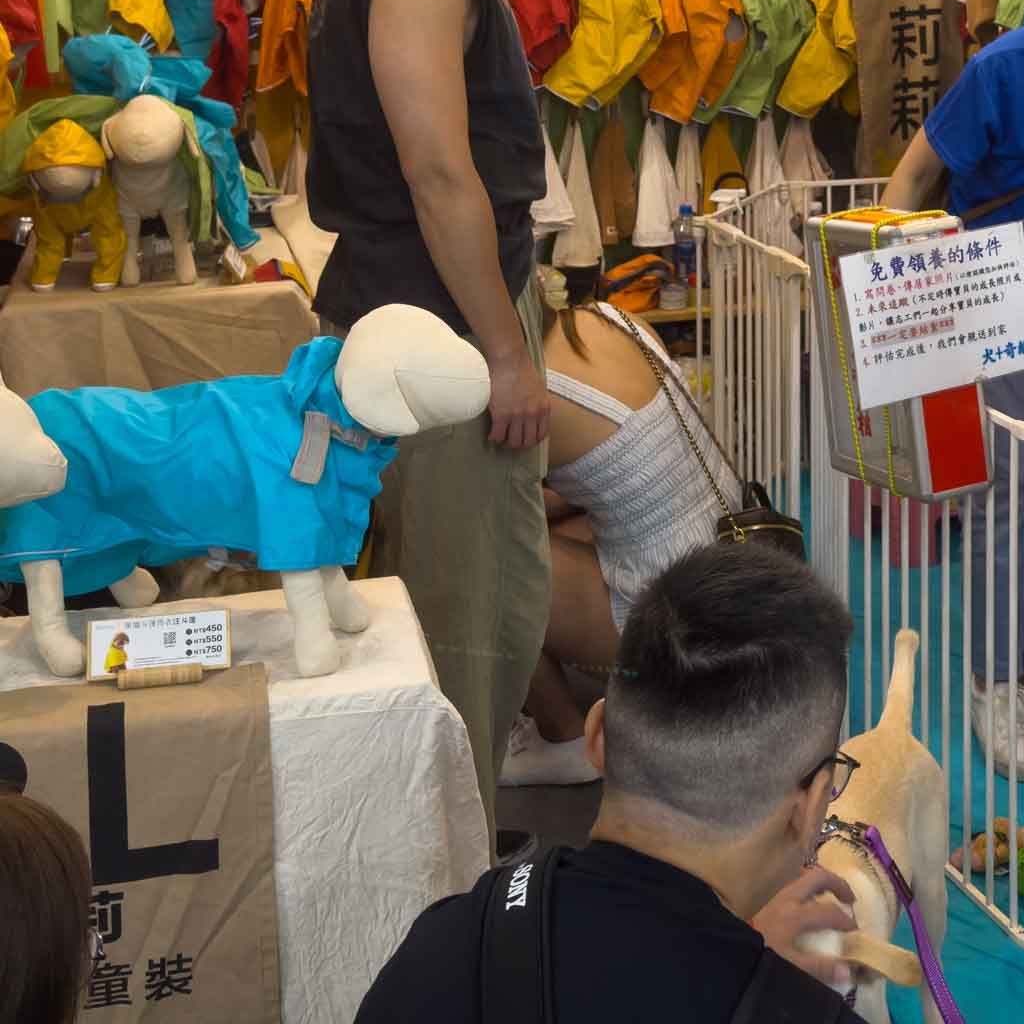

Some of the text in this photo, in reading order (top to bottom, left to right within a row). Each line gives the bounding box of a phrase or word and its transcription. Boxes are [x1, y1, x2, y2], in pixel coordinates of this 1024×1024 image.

[870, 235, 1003, 283] 免費領養的條件
[83, 953, 193, 1010] 童裝
